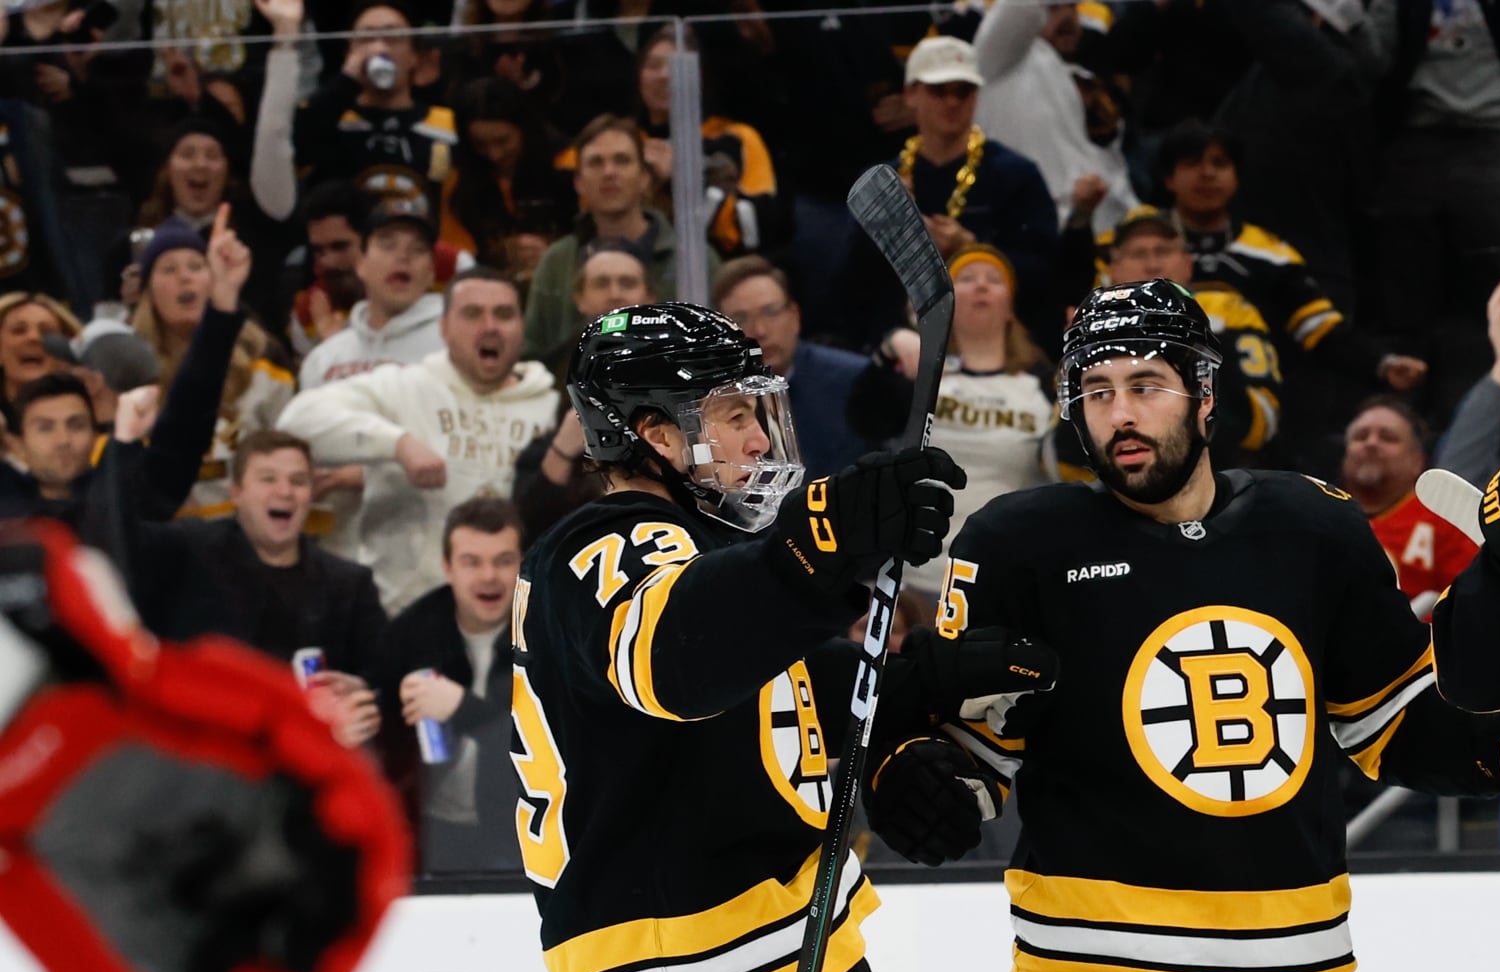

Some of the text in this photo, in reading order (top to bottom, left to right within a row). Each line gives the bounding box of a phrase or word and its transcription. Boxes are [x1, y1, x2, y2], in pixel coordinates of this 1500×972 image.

[605, 315, 668, 330] TD Bank
[1090, 315, 1139, 331] CCM
[807, 475, 837, 552] CC
[1401, 521, 1435, 571] A
[569, 522, 699, 608] 73
[1009, 664, 1041, 679] CCM
